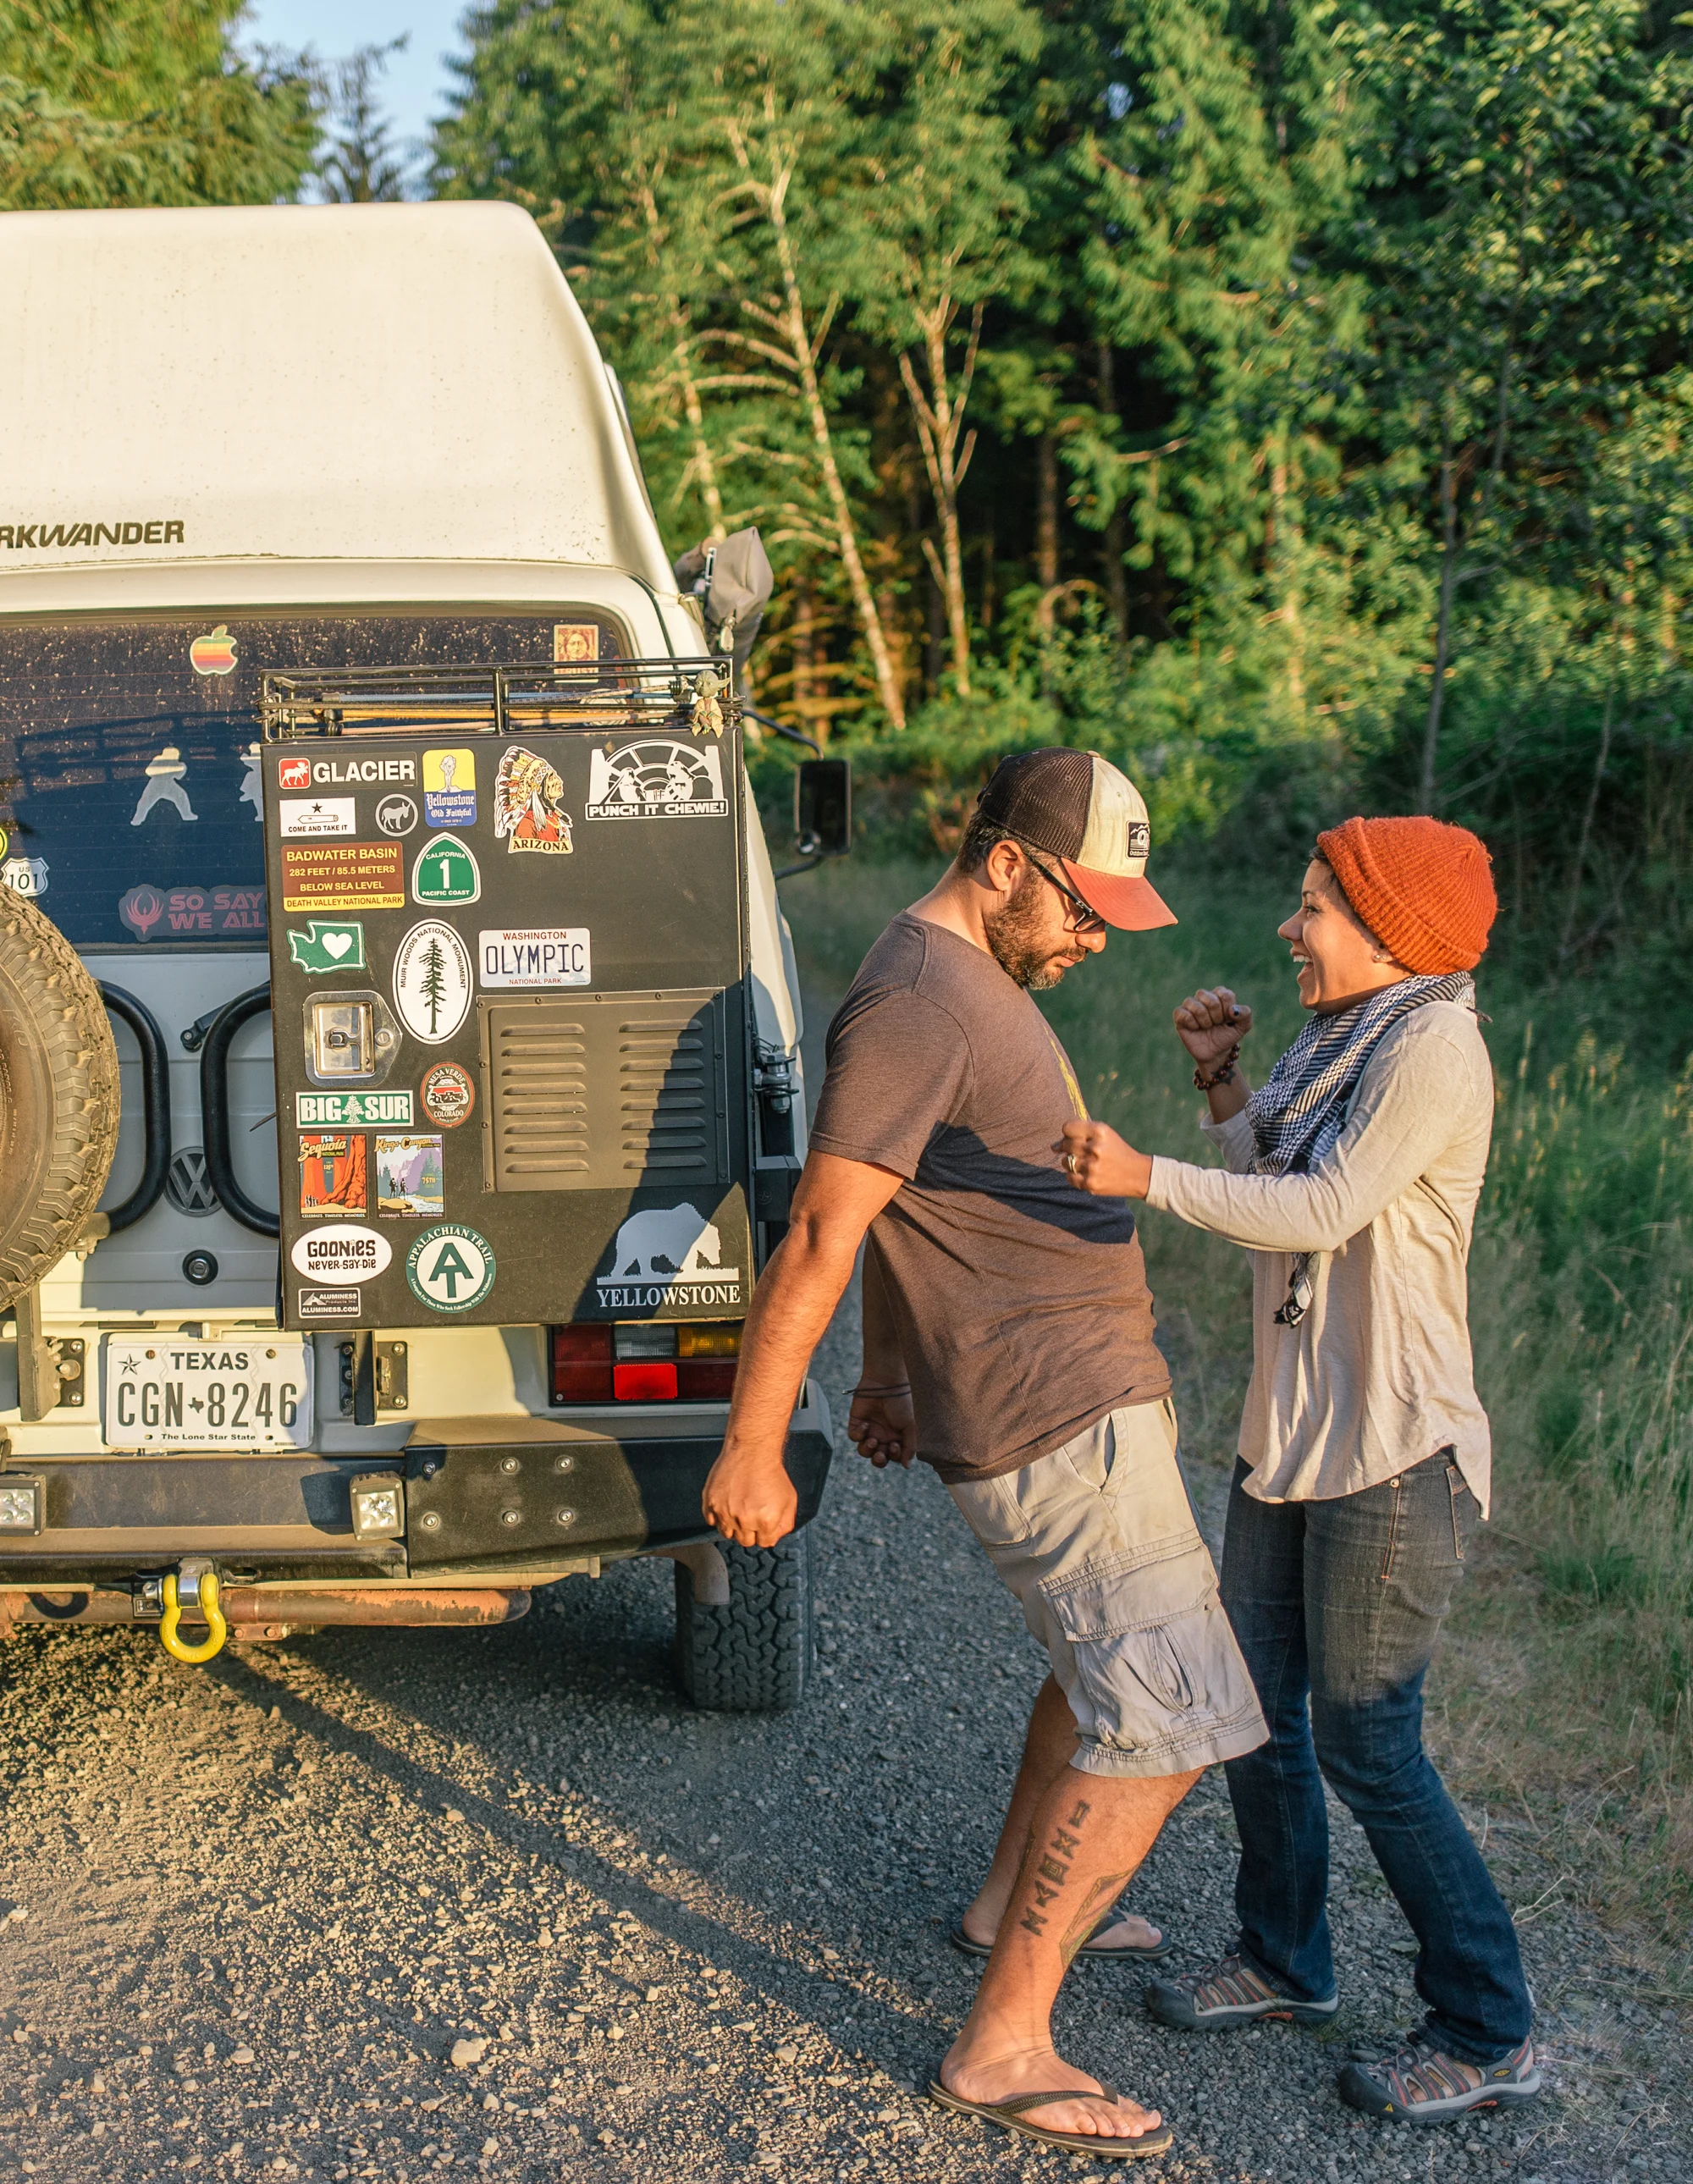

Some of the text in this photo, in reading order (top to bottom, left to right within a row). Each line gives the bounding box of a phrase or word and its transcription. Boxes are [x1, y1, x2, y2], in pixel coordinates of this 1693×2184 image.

[313, 760, 416, 783] GLACIER
[426, 793, 474, 809] Yellowstone
[589, 802, 724, 817] PUNCH IT CHEWIE!
[431, 808, 472, 818] Old Faithful
[513, 839, 569, 851] ARIZONA
[287, 847, 397, 862] BADWATER BASIN
[290, 868, 306, 876] 282
[332, 867, 335, 875] /
[358, 865, 395, 874] METERS
[439, 859, 449, 889] 1
[9, 874, 38, 889] 101
[300, 883, 333, 891] BELOW
[356, 881, 384, 890] LEVEL
[169, 892, 263, 911] SO SAY
[168, 911, 265, 929] WE ALL
[503, 931, 566, 940] WASHINGTON
[402, 937, 418, 965] WOODS
[417, 928, 453, 943] NATIONAL
[451, 944, 466, 989] MONUMENT
[486, 944, 583, 974] OLYMPIC
[428, 1068, 466, 1084] MESA VERDE
[301, 1095, 409, 1122] BIG SUR
[298, 1139, 347, 1161] Sequoia
[408, 1227, 493, 1269] APPALACHIAN TRAIL
[596, 1285, 741, 1307] YELLOWSTONE
[170, 1352, 249, 1371] TEXAS
[118, 1382, 297, 1428] CGN 8246
